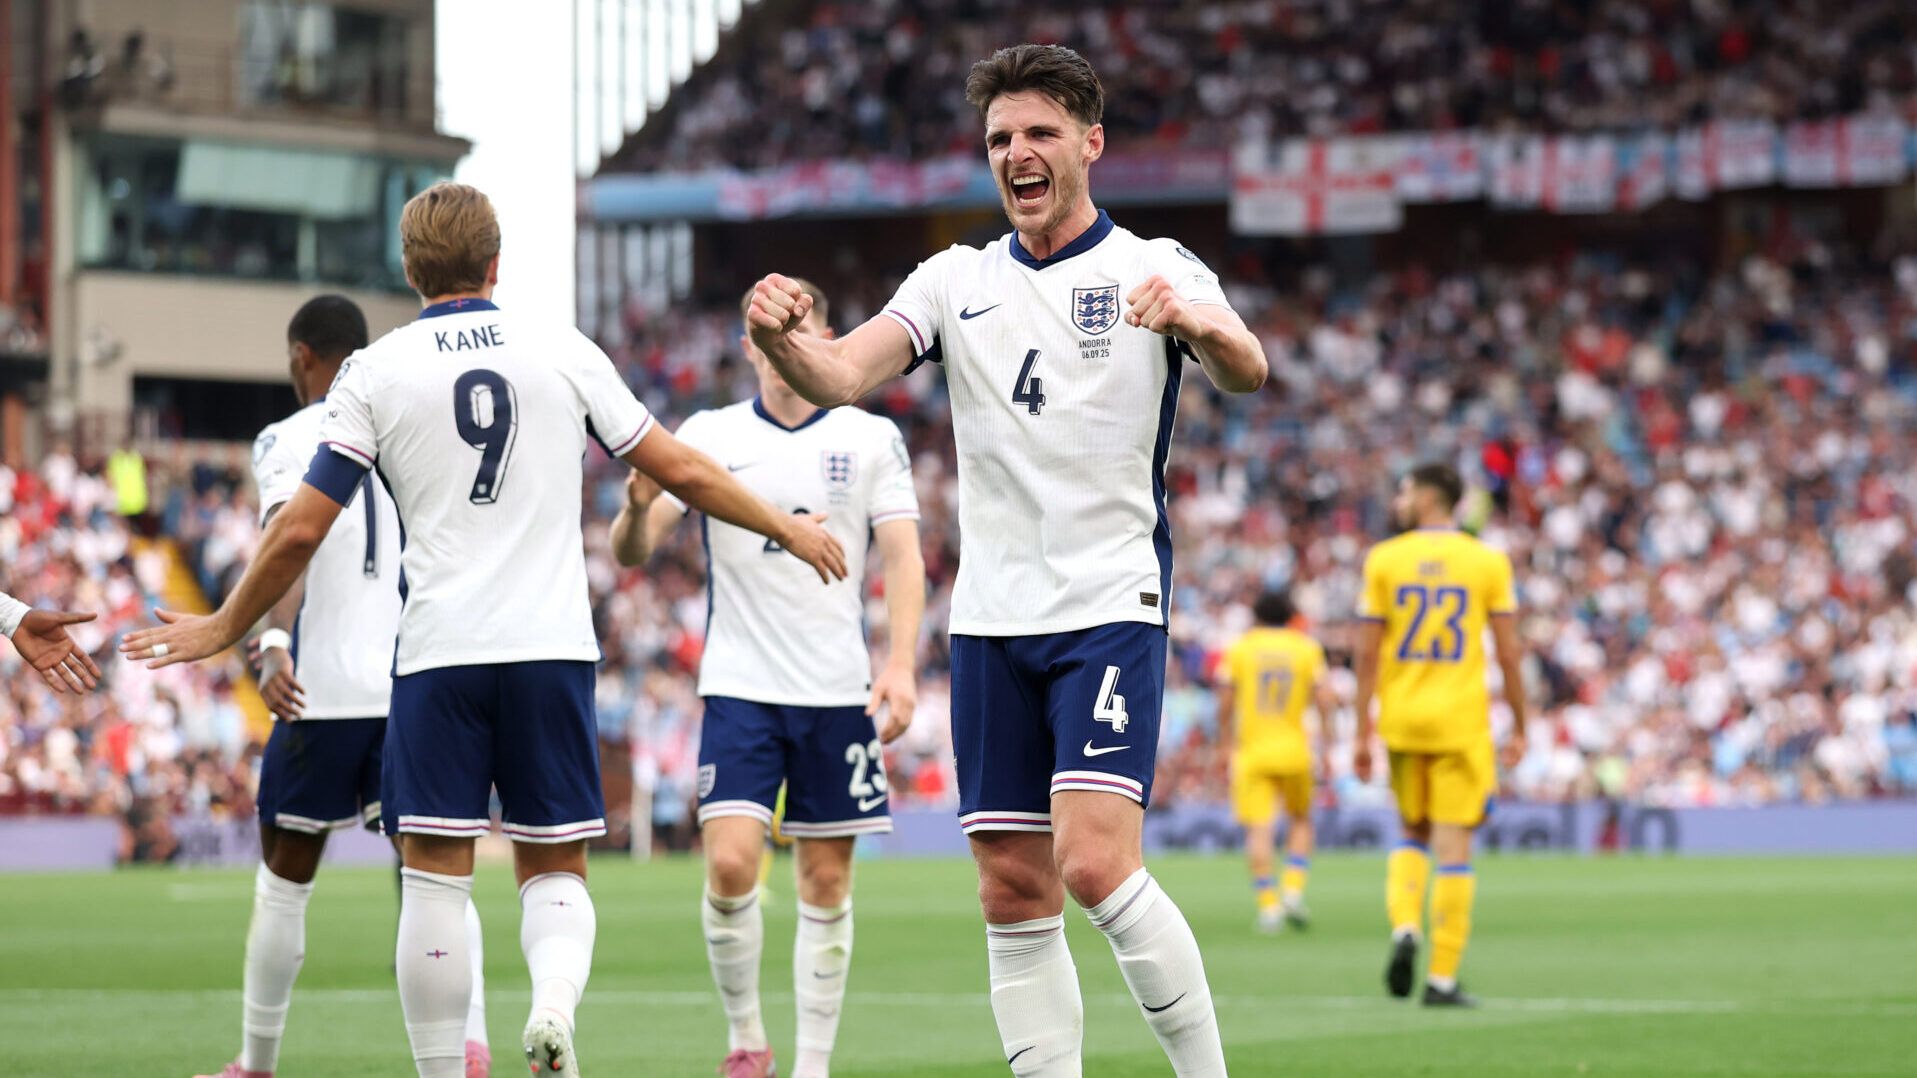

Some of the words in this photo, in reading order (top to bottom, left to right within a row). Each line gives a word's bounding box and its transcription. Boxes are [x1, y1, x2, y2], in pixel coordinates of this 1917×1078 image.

[435, 324, 504, 352] KANE
[1078, 338, 1112, 349] ANDORRA
[1081, 348, 1110, 360] 06.09.25
[1012, 348, 1046, 415] 4
[454, 369, 518, 504] 9
[1396, 584, 1467, 661] 23
[1093, 665, 1128, 733] 4
